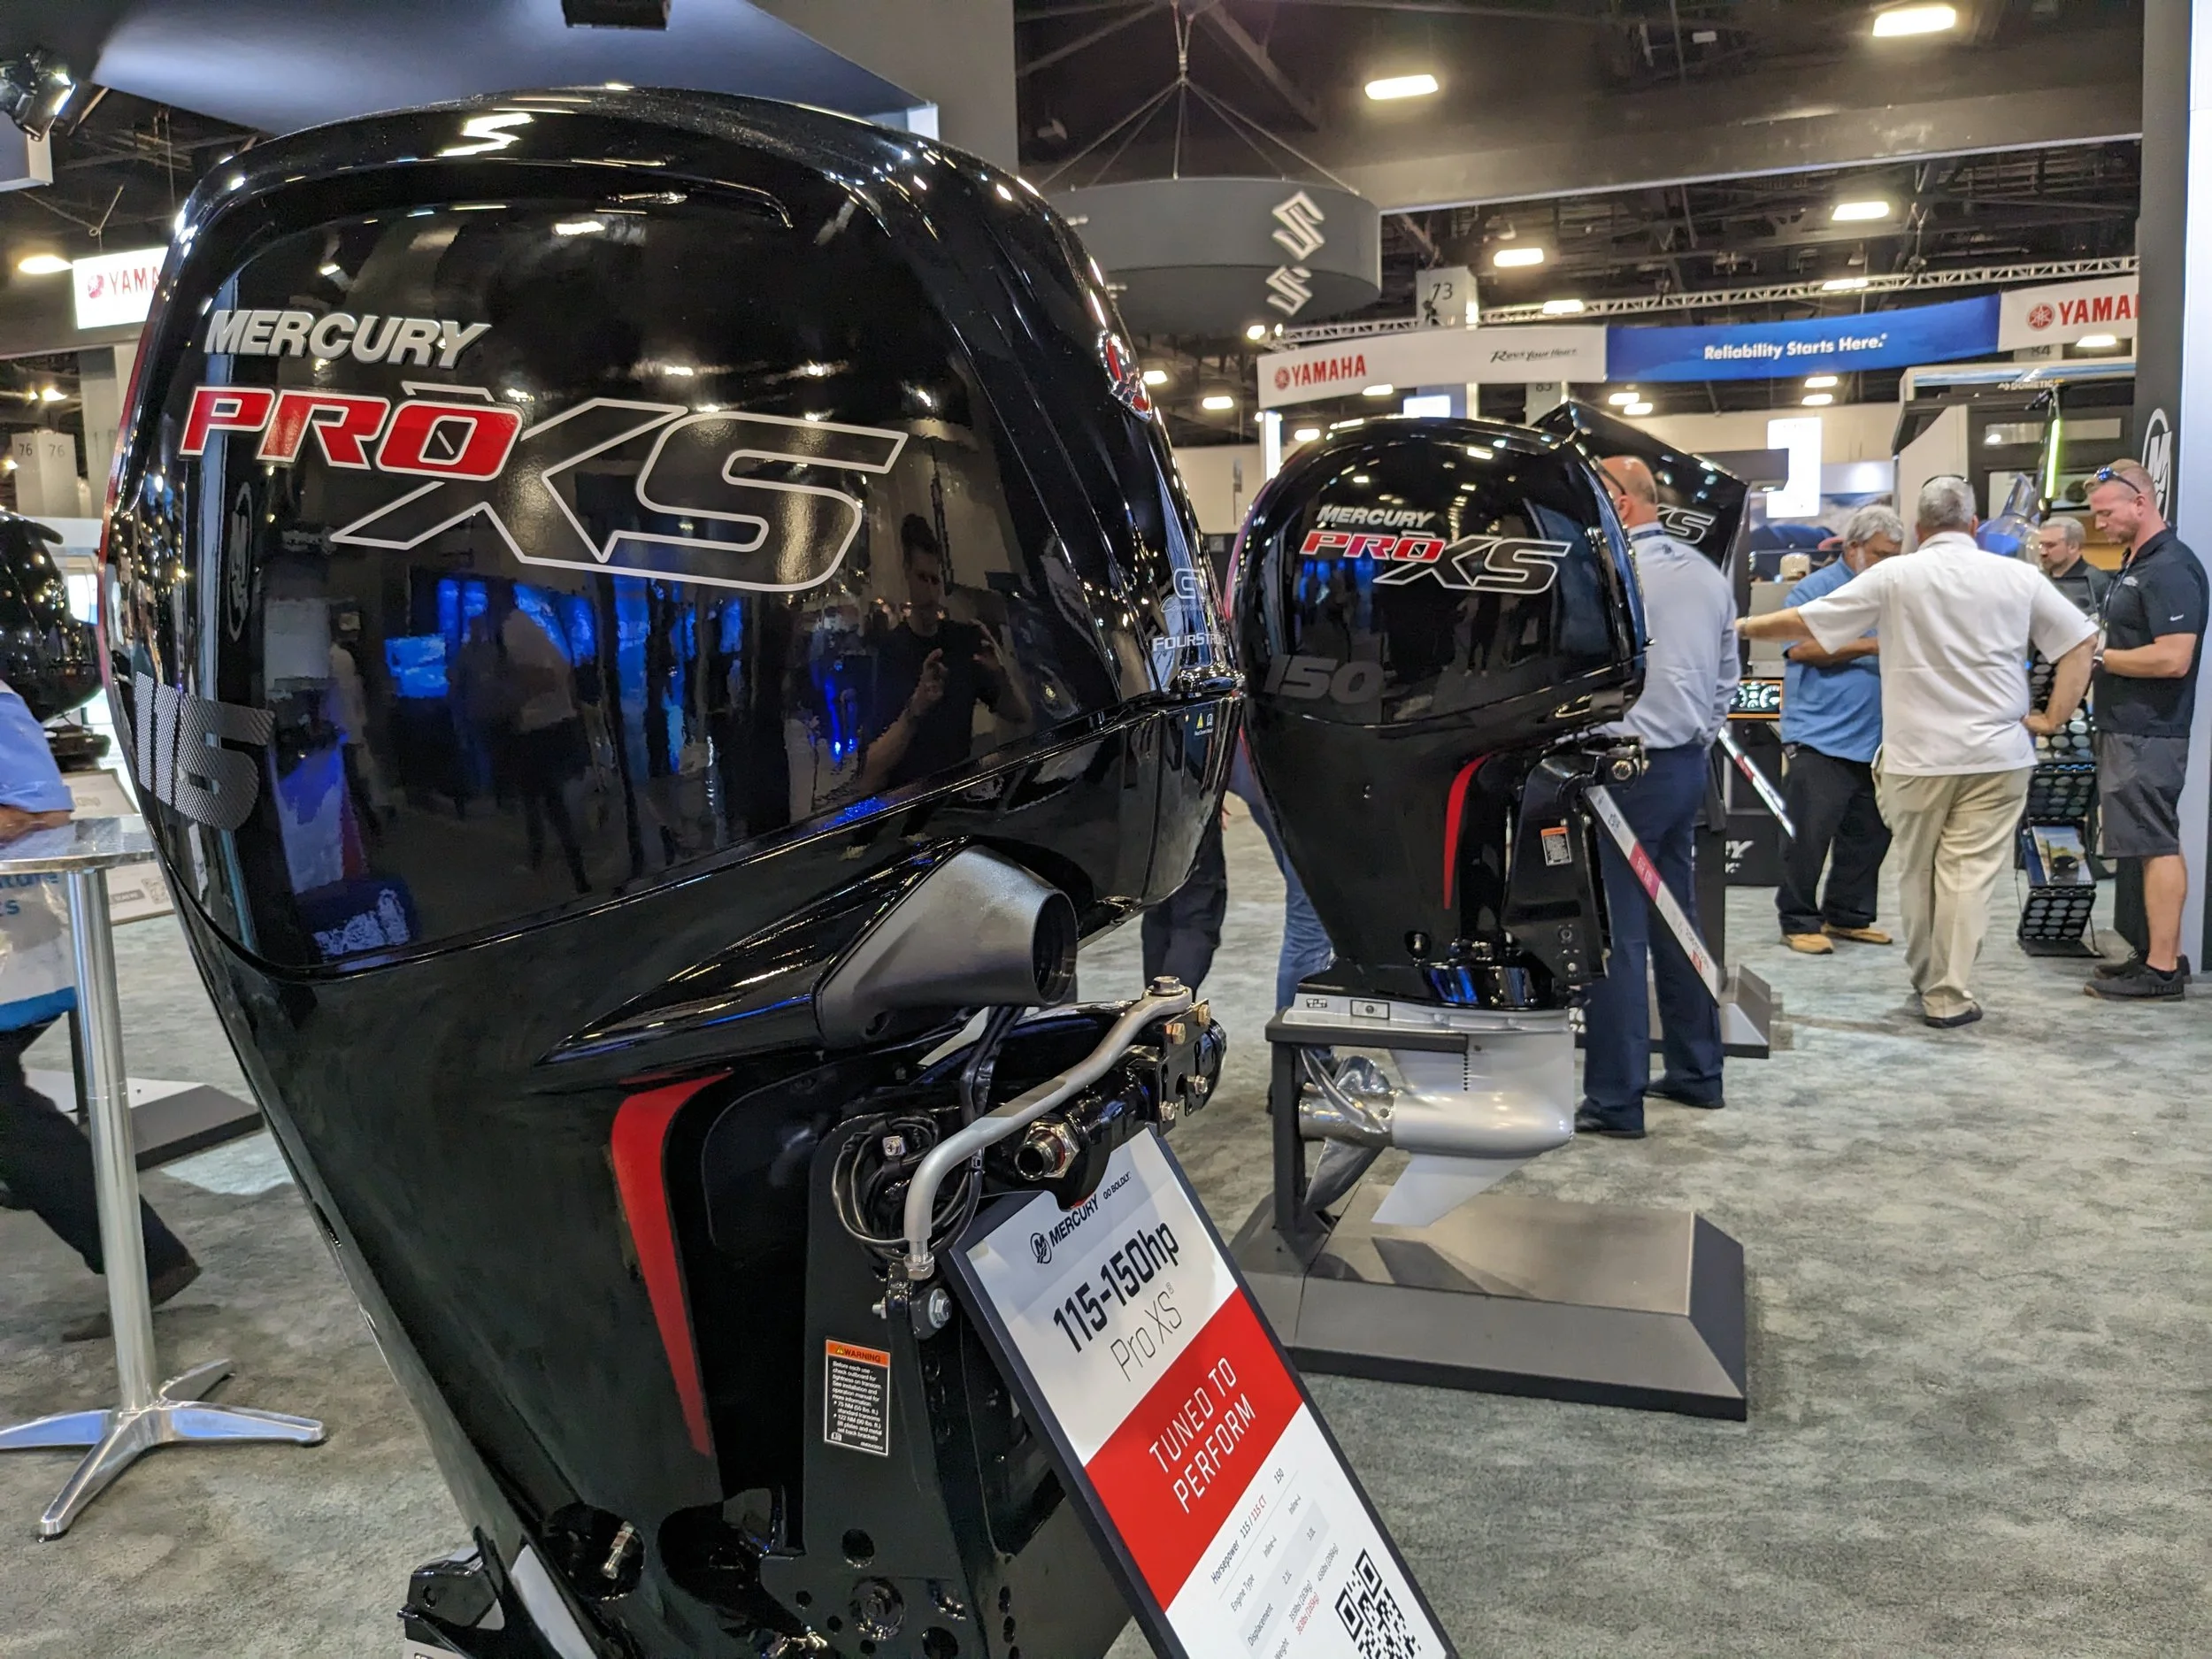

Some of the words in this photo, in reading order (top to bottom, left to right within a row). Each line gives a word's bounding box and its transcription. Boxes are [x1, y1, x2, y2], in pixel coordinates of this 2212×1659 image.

[1432, 281, 1453, 303] 73
[203, 310, 493, 369] MERCURY
[1704, 344, 1782, 360] Reliability
[1786, 340, 1834, 356] Starts
[1291, 354, 1366, 387] YAMAHA
[19, 443, 33, 457] 76
[49, 443, 65, 458] 76
[179, 385, 525, 482] PRO
[328, 380, 909, 593] XS
[1316, 503, 1436, 529] MERCURY
[1300, 531, 1447, 563] PRO
[1372, 531, 1571, 595] XS
[1263, 655, 1386, 704] 150
[1049, 1194, 1100, 1248] MERCURY
[1102, 1186, 1112, 1200] GO
[1053, 1222, 1179, 1353] 115-150hp
[844, 1348, 881, 1363] WARNING
[1110, 1326, 1156, 1382] Pro
[1148, 1386, 1214, 1473] TUNED
[1208, 1357, 1237, 1398] TO
[1172, 1393, 1256, 1514] PERFORM
[1210, 1540, 1240, 1585] Horsepower
[1240, 1521, 1251, 1539] 115
[1250, 1504, 1262, 1521] 115
[1258, 1494, 1267, 1509] CT
[1274, 1467, 1284, 1485] 150
[1230, 1588, 1246, 1612] Engine
[1243, 1574, 1256, 1592] Type
[1248, 1602, 1274, 1647] Displacement
